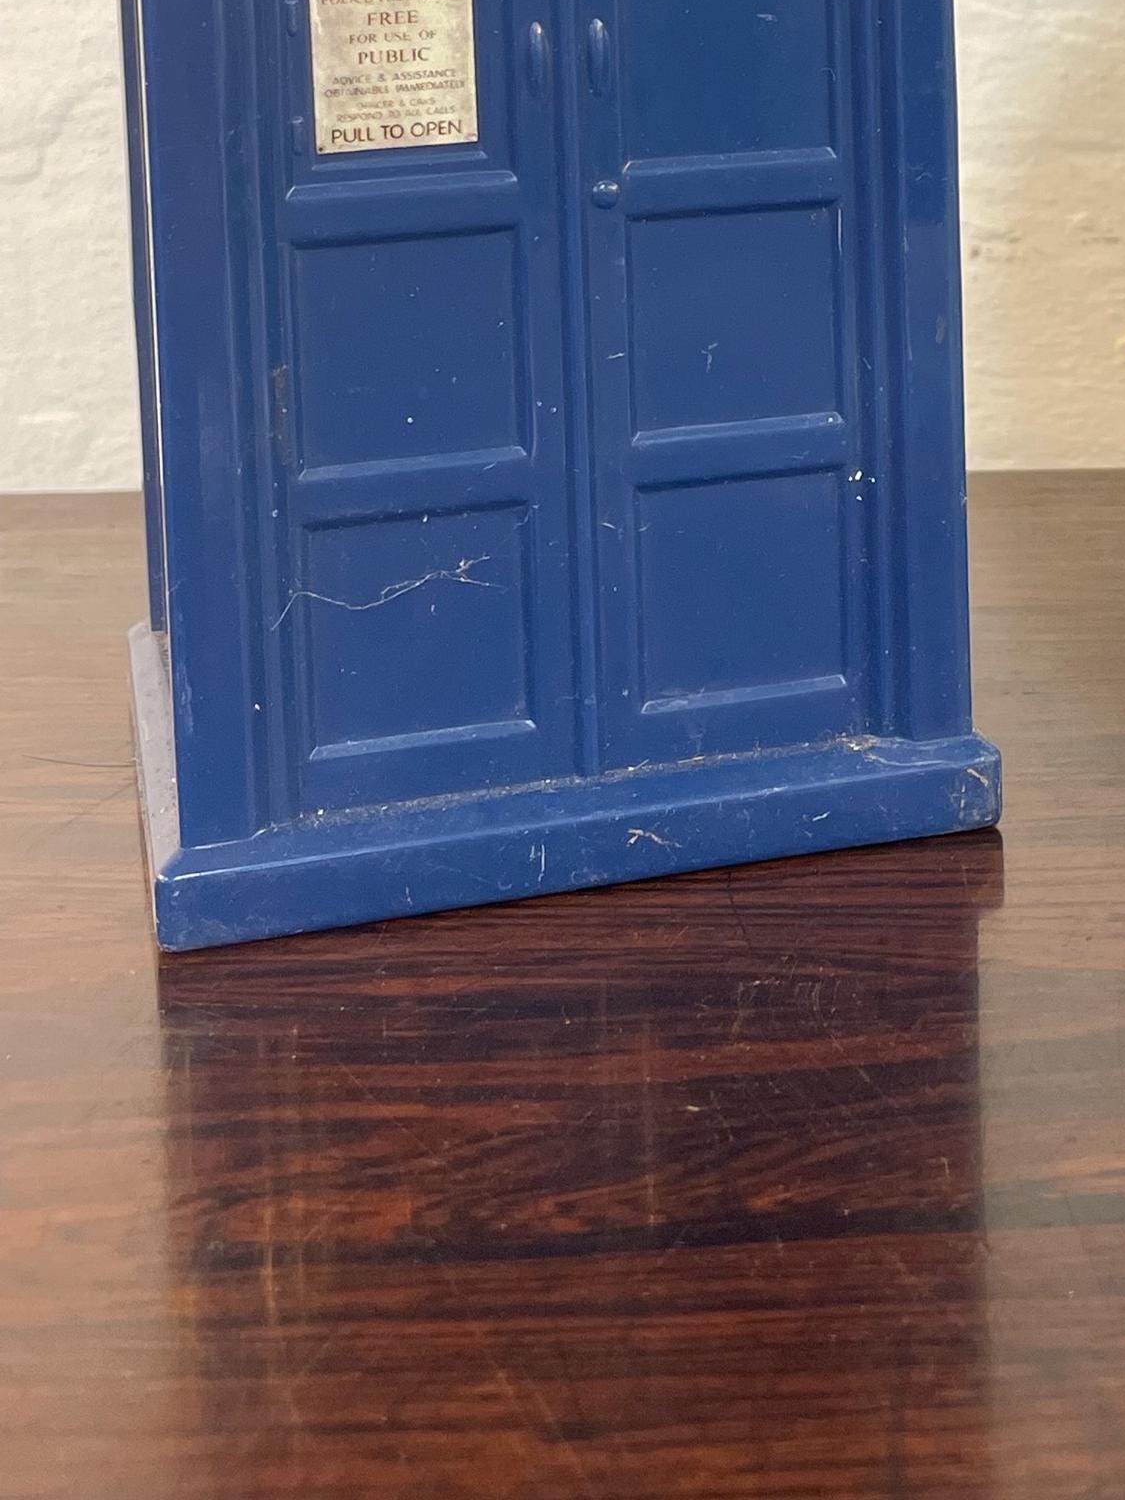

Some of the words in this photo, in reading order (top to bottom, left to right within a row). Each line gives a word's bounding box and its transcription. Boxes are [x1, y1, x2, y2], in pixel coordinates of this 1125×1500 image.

[367, 10, 418, 26] FREE
[349, 33, 377, 44] FOR
[384, 31, 411, 42] USE
[419, 29, 436, 40] OF
[358, 47, 430, 65] PUBLIC
[332, 76, 371, 86] ADVICE
[377, 74, 386, 82] &
[392, 69, 457, 81] ASSISTANCE
[331, 124, 375, 144] PULL
[381, 124, 404, 140] TO
[410, 119, 463, 138] OPEN
